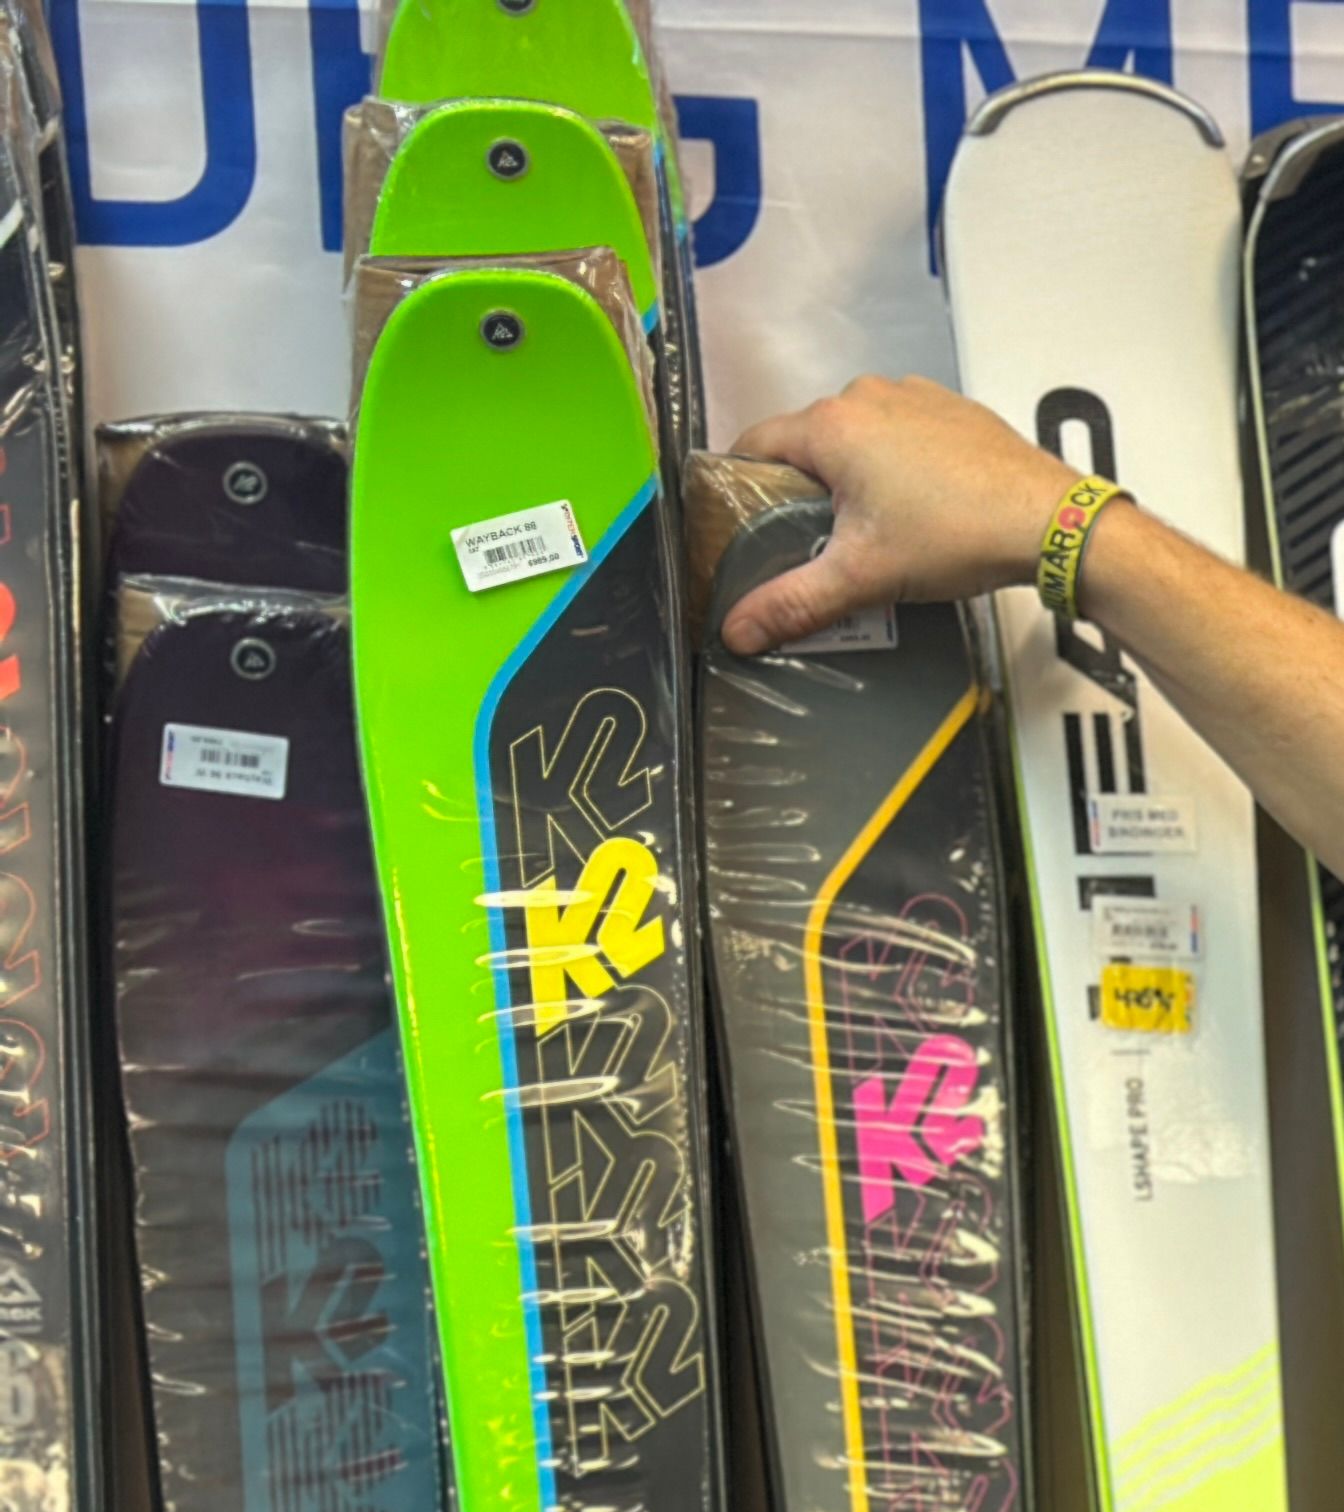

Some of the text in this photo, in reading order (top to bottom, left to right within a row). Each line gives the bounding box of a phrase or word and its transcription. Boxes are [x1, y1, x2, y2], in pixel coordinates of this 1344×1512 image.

[465, 525, 522, 548] WAYBACK
[523, 836, 666, 1038] K2
[852, 1033, 988, 1225] K2
[1124, 1077, 1154, 1203] LSHAPE PRO
